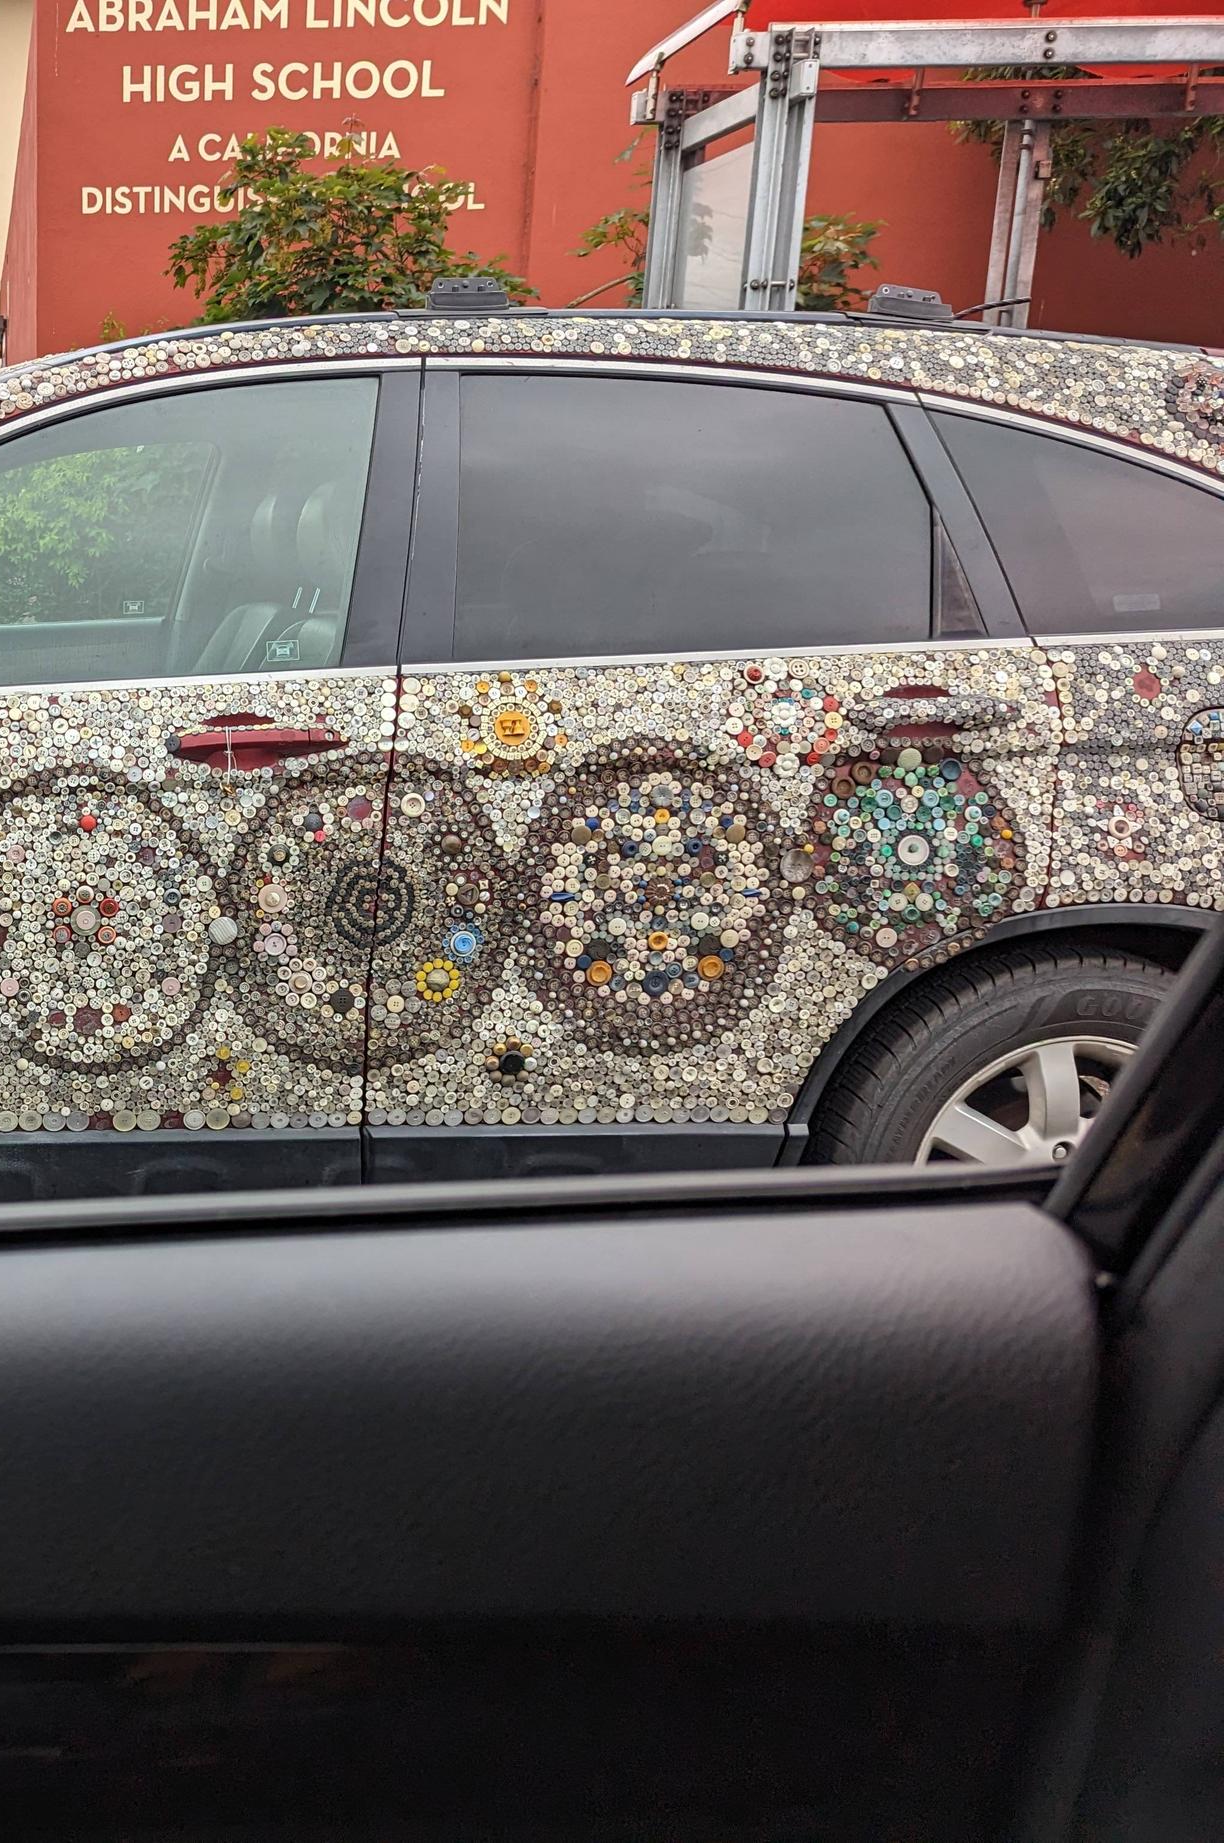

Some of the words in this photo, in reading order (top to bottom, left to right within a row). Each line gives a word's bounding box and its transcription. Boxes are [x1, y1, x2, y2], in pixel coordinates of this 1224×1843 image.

[65, 0, 289, 32] ABRAHAM
[305, 0, 509, 29] LINCOLN
[122, 64, 234, 103] HIGH
[251, 60, 445, 101] SCHOOL
[167, 134, 190, 162] A
